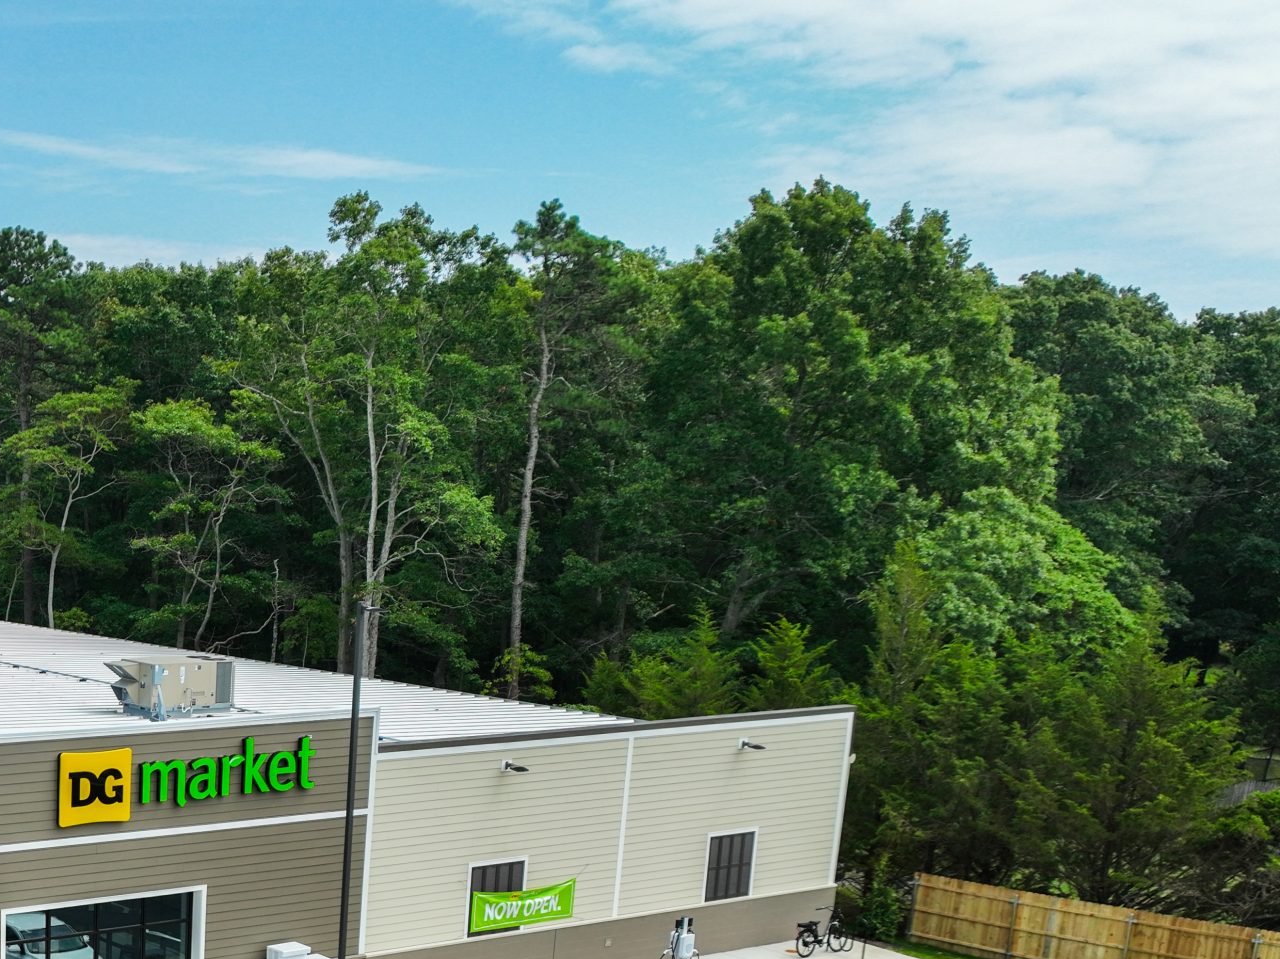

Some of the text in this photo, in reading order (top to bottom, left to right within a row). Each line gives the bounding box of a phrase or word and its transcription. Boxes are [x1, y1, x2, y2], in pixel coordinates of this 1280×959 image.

[68, 735, 317, 808] DG market
[483, 901, 521, 921] NOW
[523, 894, 561, 916] OPEN.
